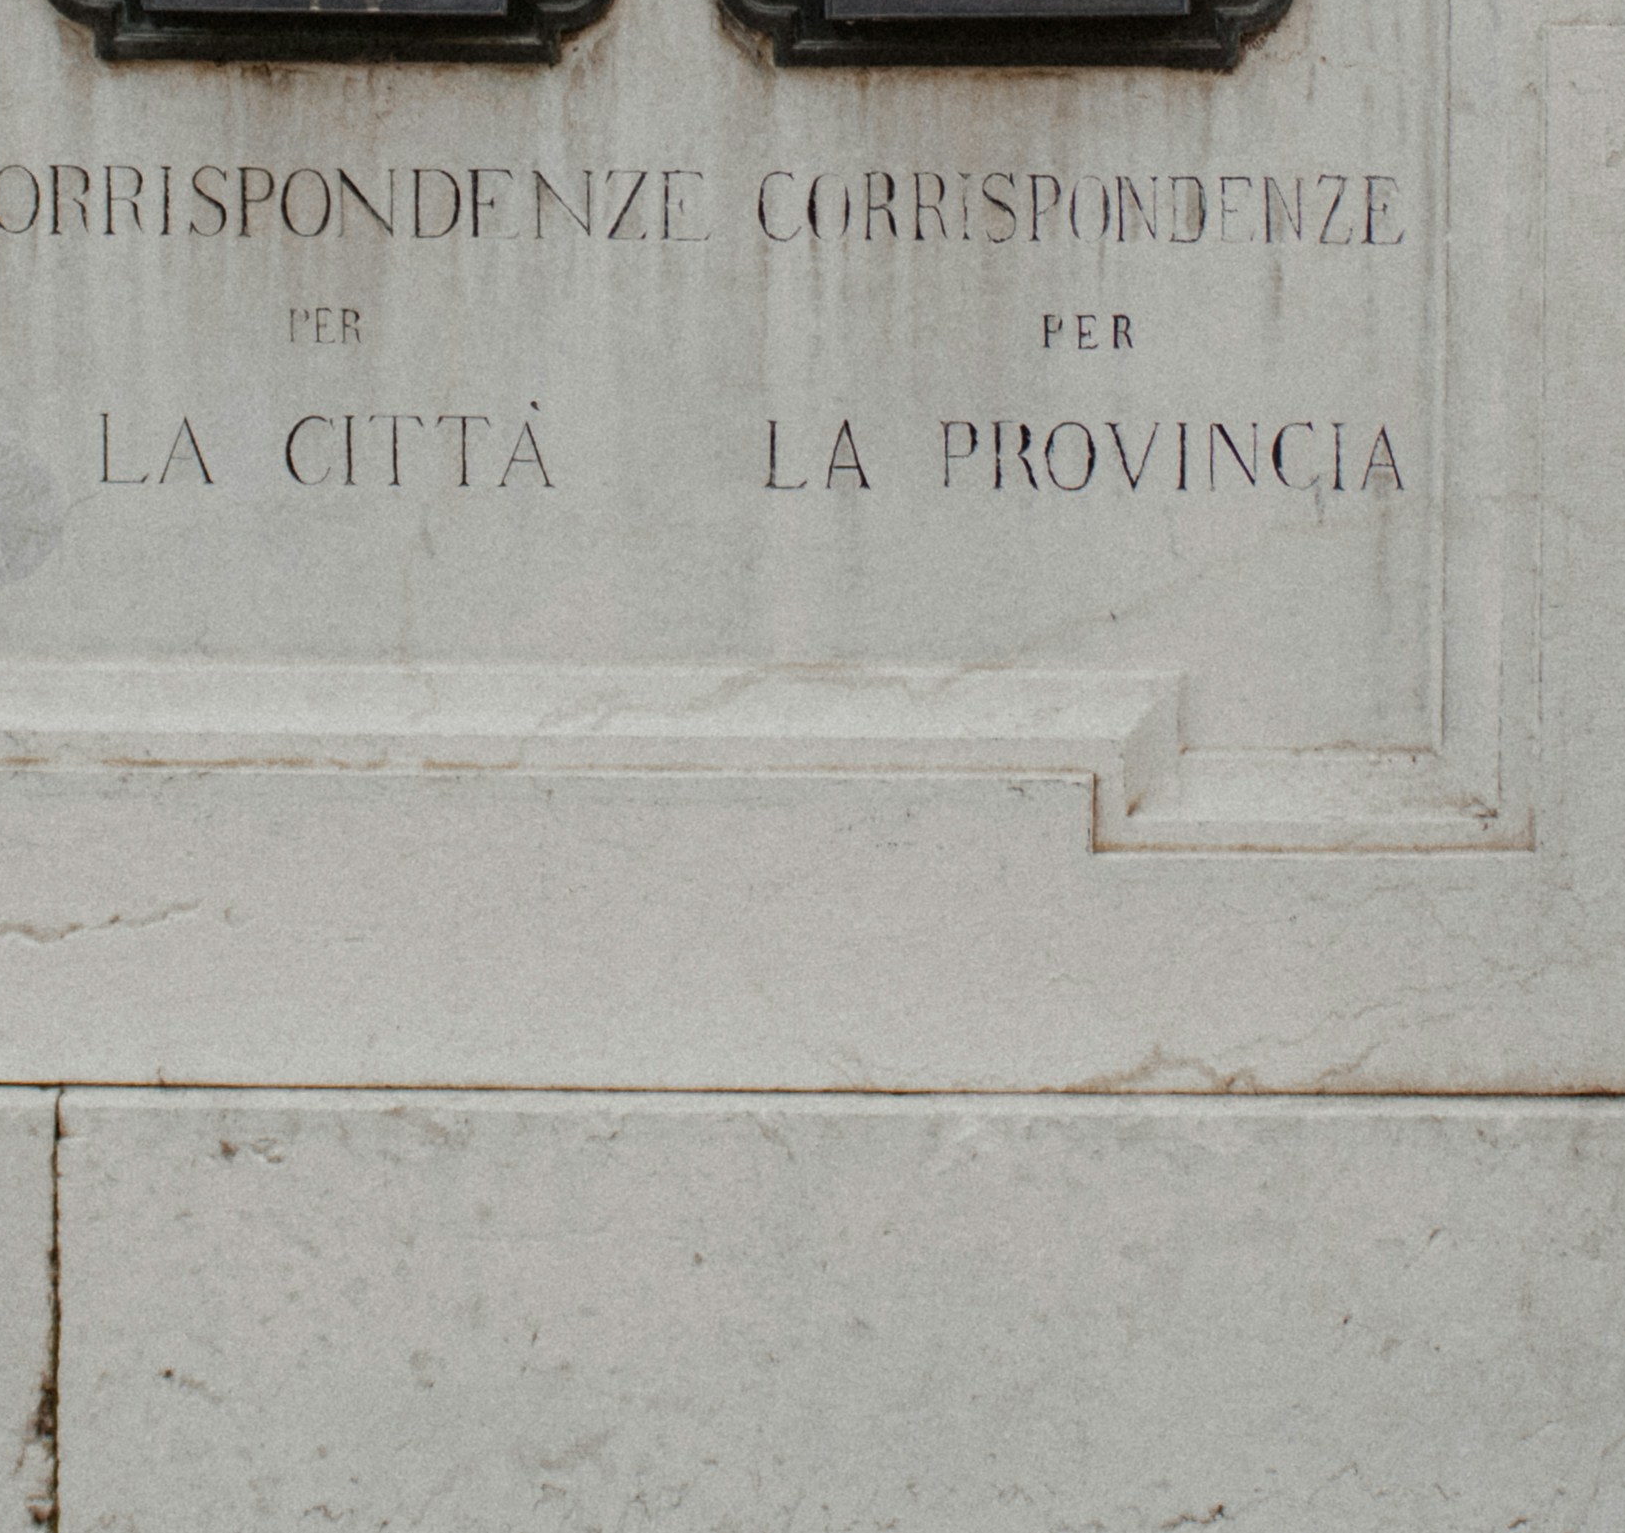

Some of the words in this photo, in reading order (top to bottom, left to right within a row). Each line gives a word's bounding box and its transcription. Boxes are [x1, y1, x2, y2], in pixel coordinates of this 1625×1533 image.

[757, 170, 1405, 246] CORRISPONDENZE
[288, 306, 362, 345] PER
[1041, 313, 1135, 350] PER
[99, 412, 215, 485] LA
[284, 400, 556, 489] CITTÀ
[764, 419, 872, 491] LA
[939, 420, 1405, 493] PROVINCIA
